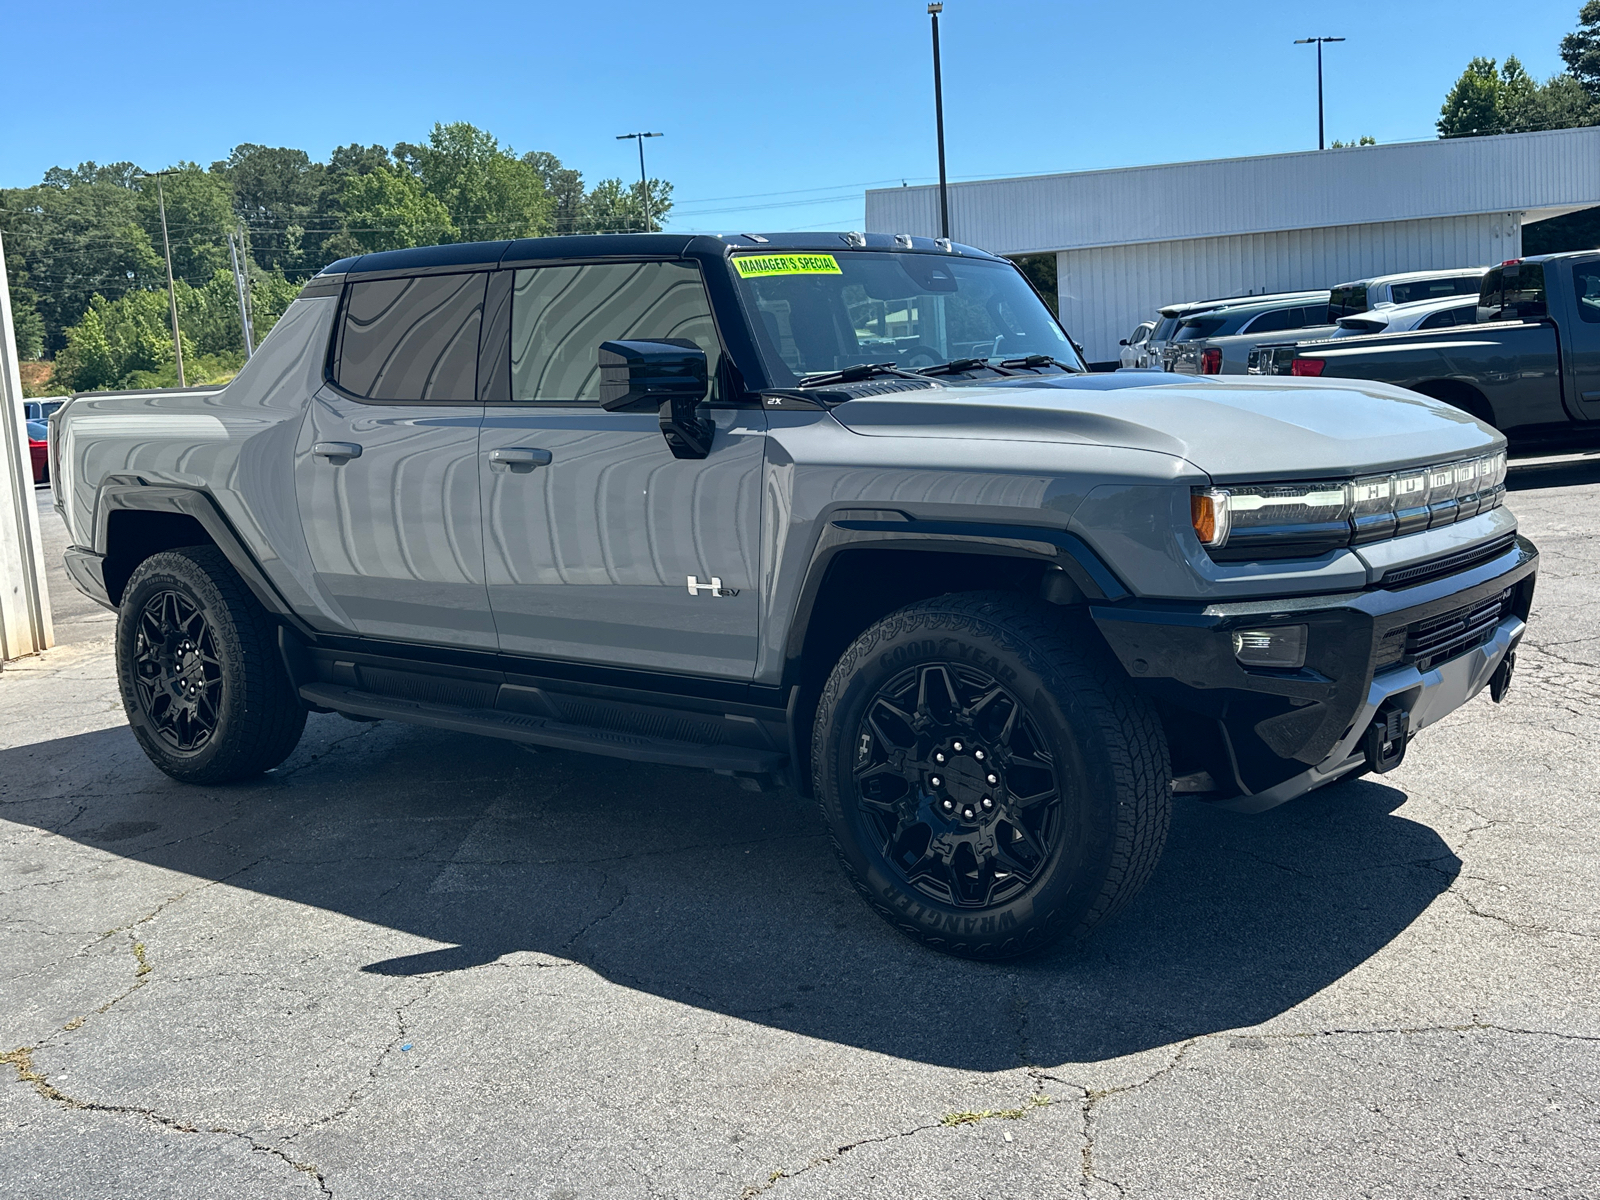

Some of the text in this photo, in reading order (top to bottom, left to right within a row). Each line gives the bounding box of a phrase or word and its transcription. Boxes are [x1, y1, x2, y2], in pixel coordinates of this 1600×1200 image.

[739, 257, 836, 273] MANAGER'S SPECIAL
[120, 614, 138, 714] WRANGLER
[882, 885, 1018, 934] WRANGLER
